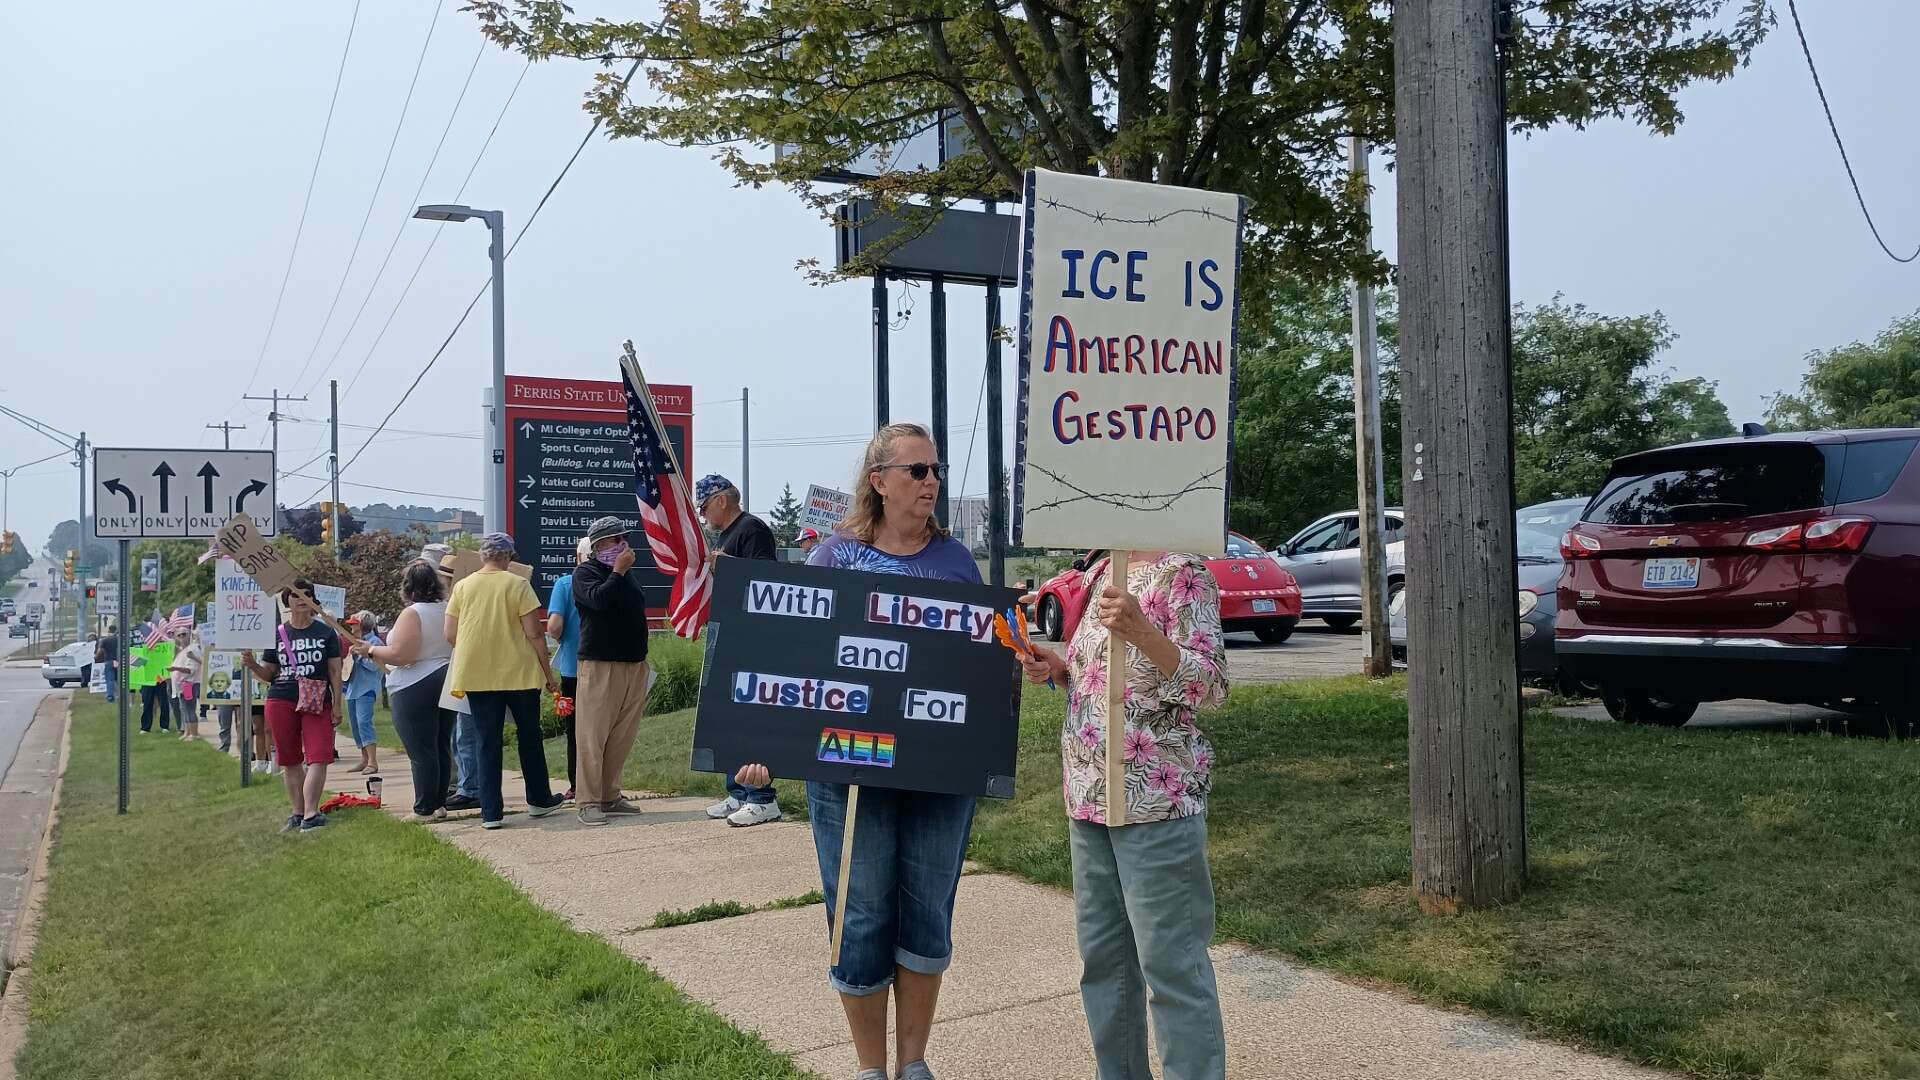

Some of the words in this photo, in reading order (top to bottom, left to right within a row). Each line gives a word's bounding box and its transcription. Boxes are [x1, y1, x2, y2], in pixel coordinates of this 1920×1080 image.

[1061, 249, 1148, 303] ICE
[1184, 260, 1224, 312] IS
[1043, 315, 1223, 376] AMERICAN
[514, 384, 561, 400] FERRIS
[564, 386, 604, 402] STATE
[608, 389, 684, 406] UNRSITY
[1052, 390, 1217, 445] GESTAPO
[540, 424, 553, 433] MI
[555, 425, 591, 436] College
[593, 426, 603, 435] of
[605, 427, 629, 438] Opto
[540, 443, 571, 453] Sports
[573, 444, 614, 455] Complex
[586, 459, 600, 468] Ice
[602, 459, 610, 468] &
[541, 477, 569, 487] Katke
[570, 478, 591, 487] Golf
[592, 479, 625, 488] Course
[541, 497, 595, 507] Admissions
[811, 498, 833, 512] HANDS
[100, 517, 138, 528] ONLY
[145, 517, 184, 528] ONLY
[189, 517, 227, 528] ONLY
[540, 517, 568, 526] David
[570, 517, 579, 526] L.
[220, 523, 247, 553] RIP
[540, 536, 565, 545] FLITE
[240, 545, 274, 575] SNAP
[541, 554, 565, 563] Main
[541, 572, 559, 583] Top
[1670, 566, 1696, 580] 2142
[225, 594, 259, 610] SINCE
[752, 584, 830, 618] With
[868, 592, 994, 640] Liberty
[229, 613, 263, 631] 1776
[839, 642, 906, 671] and
[735, 672, 868, 713] Justice
[906, 690, 965, 721] For
[818, 731, 891, 764] ALL
